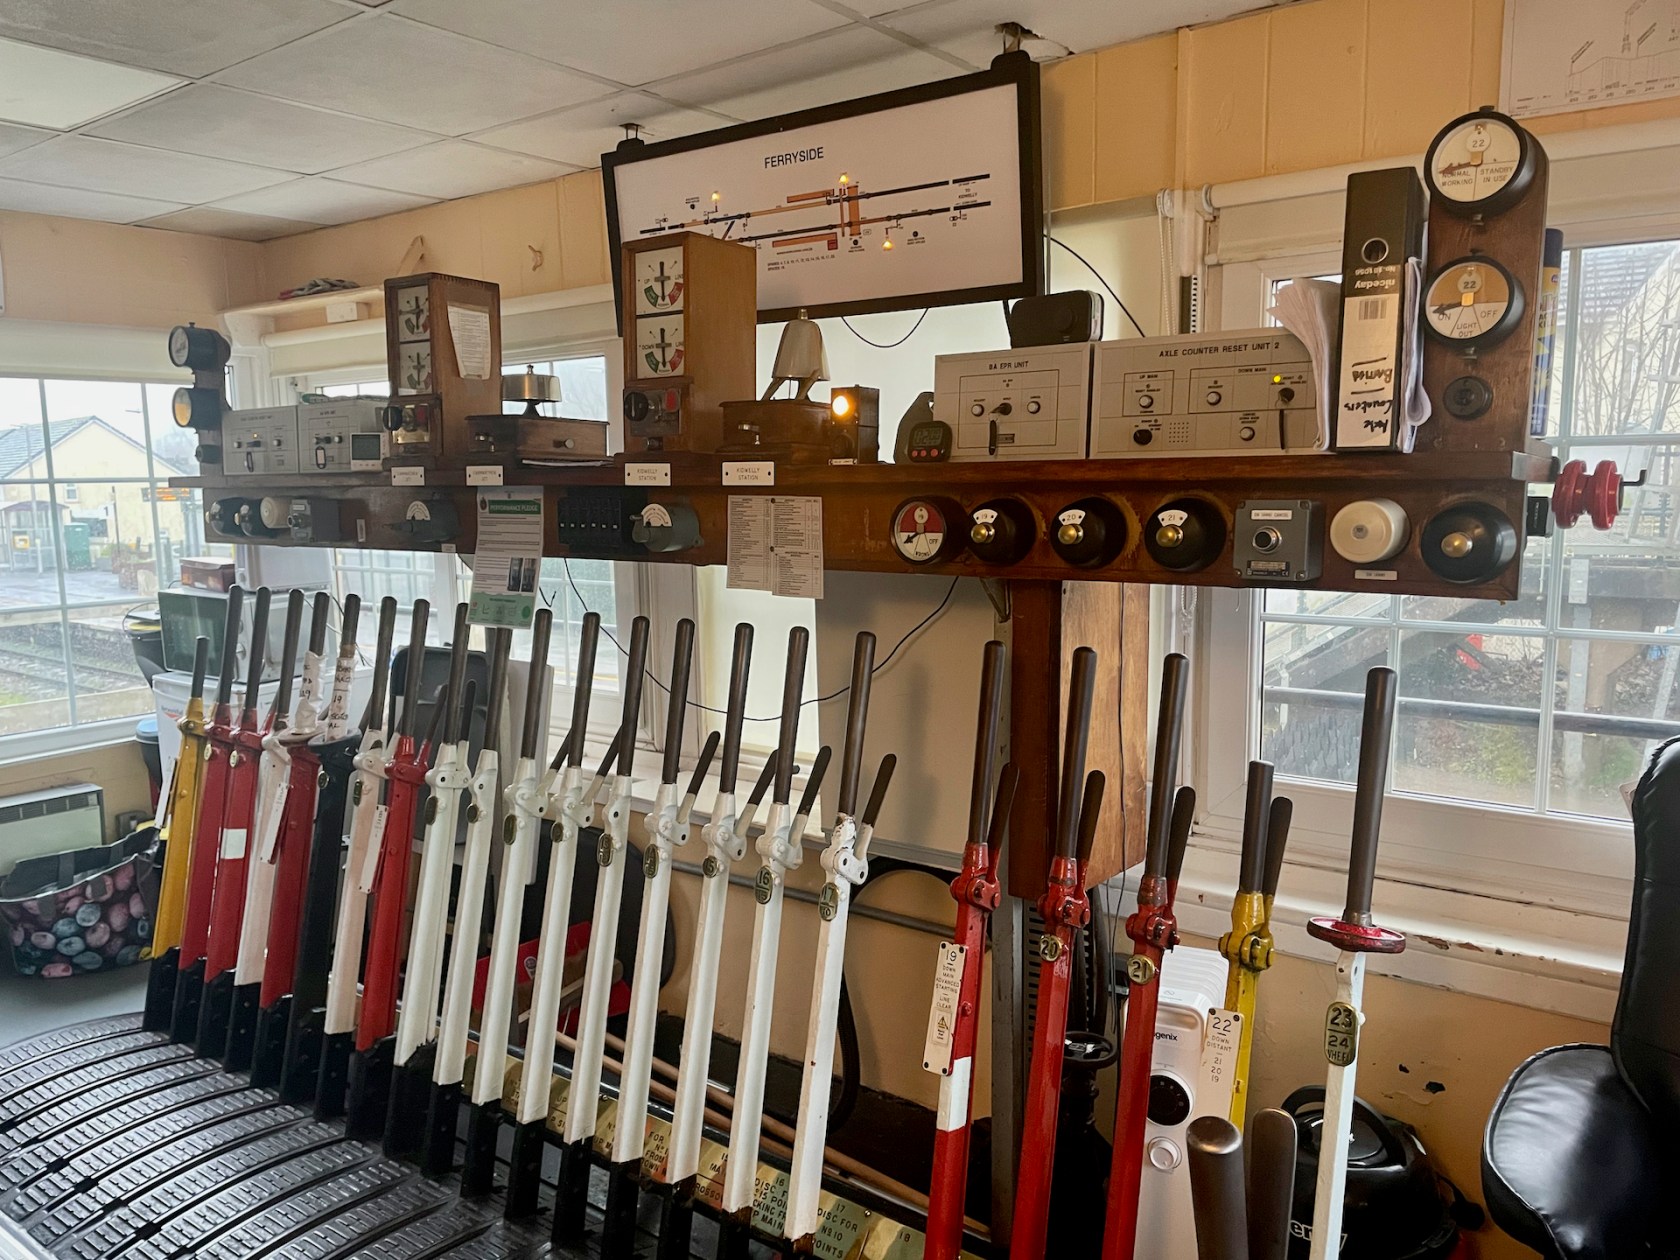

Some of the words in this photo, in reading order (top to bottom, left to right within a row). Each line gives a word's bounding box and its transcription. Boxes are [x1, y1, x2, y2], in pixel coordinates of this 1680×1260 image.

[1472, 138, 1486, 148] 22
[764, 146, 824, 168] FERRYSIDE
[1480, 165, 1514, 176] STANDBY
[1441, 177, 1474, 187] WORKING
[1482, 174, 1490, 183] IN
[1490, 174, 1508, 182] USE
[1354, 279, 1395, 290] niceday
[1463, 280, 1476, 290] 22
[1480, 309, 1498, 319] OFF
[1456, 322, 1478, 330] LIGHT
[1458, 330, 1474, 338] OUT
[1158, 350, 1180, 358] AXLE
[1182, 347, 1219, 356] COUNTER
[1222, 344, 1248, 354] RESET
[1252, 342, 1271, 352] UNIT
[1274, 342, 1280, 350] 2
[1014, 360, 1029, 368] UNIT
[1066, 513, 1077, 522] 20
[1167, 514, 1176, 522] 21
[759, 870, 770, 885] 16
[1042, 939, 1058, 957] 20
[942, 964, 956, 972] DOWN
[1132, 960, 1148, 980] 21
[936, 978, 960, 988] ADVANCED
[936, 984, 958, 994] STARTING
[940, 996, 950, 1004] LINE
[1330, 1007, 1353, 1028] 23
[1212, 1016, 1232, 1033] 22
[1154, 1032, 1177, 1041] genix
[1211, 1035, 1230, 1045] DOWN
[1328, 1035, 1349, 1049] 24
[1206, 1042, 1232, 1053] DISTANT
[1214, 1057, 1222, 1065] 21
[1211, 1066, 1222, 1075] 20
[1211, 1075, 1220, 1083] 19
[649, 1132, 664, 1144] FOR
[645, 1150, 664, 1163] FROM
[755, 1178, 776, 1194] DISC
[776, 1177, 785, 1186] 16
[752, 1199, 776, 1215] CKING
[770, 1196, 787, 1210] POI
[836, 1203, 846, 1214] 17
[760, 1214, 784, 1230] MAIN
[817, 1208, 838, 1223] DISC
[840, 1218, 858, 1233] FOR
[900, 1231, 912, 1244] 18
